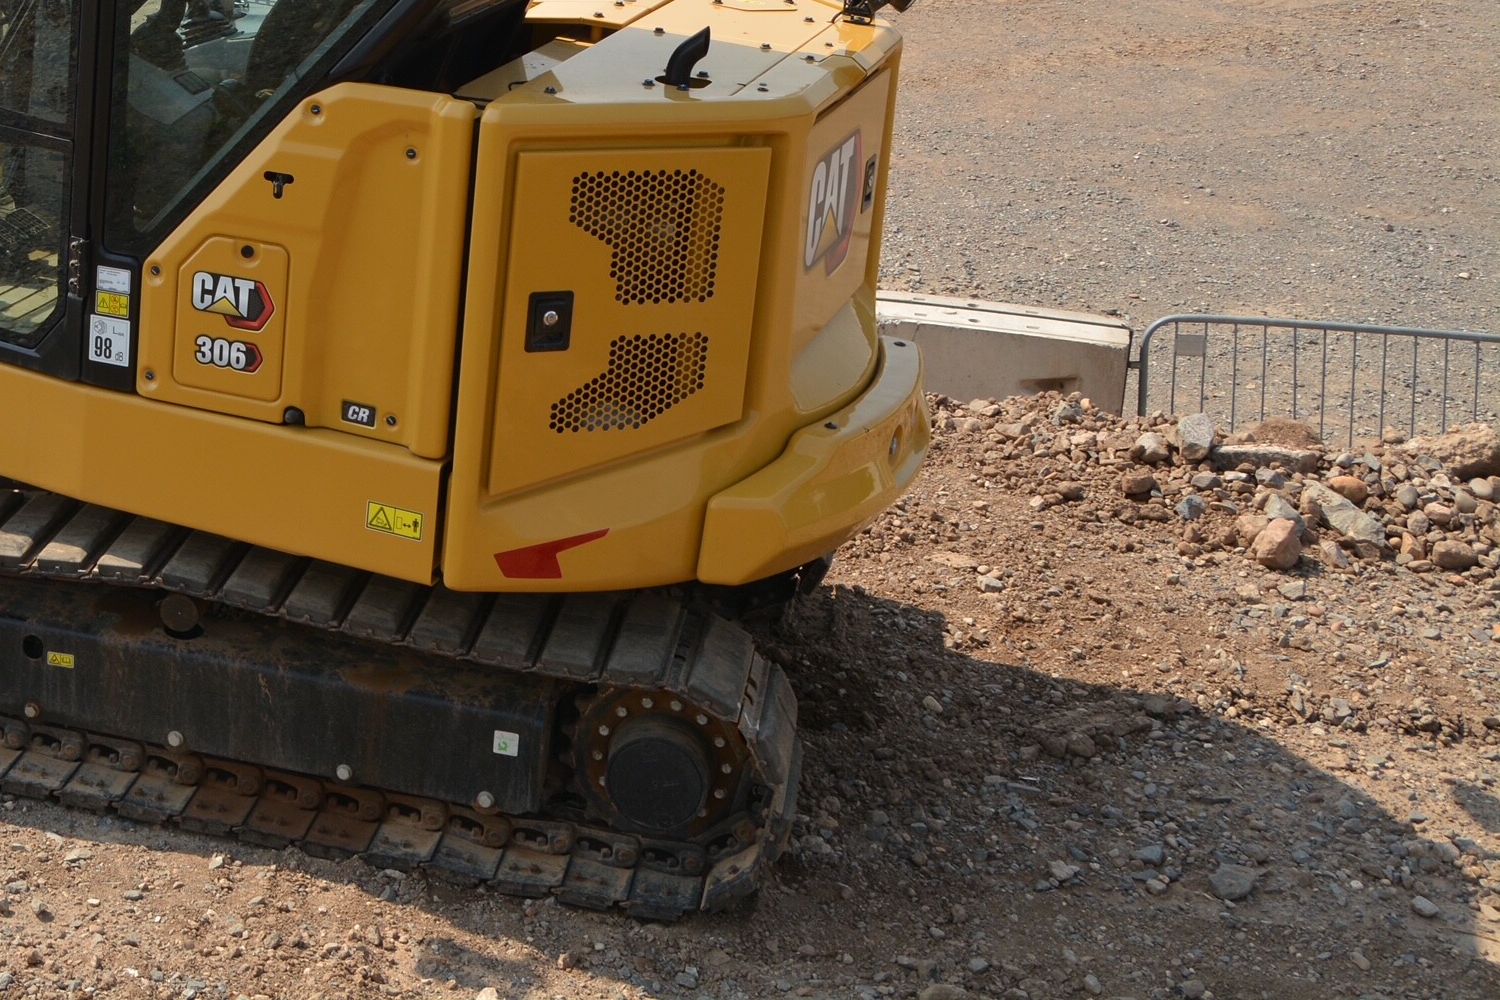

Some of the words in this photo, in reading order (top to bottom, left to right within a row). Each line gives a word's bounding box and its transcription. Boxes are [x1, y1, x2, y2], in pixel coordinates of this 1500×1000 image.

[805, 135, 856, 267] CAT
[192, 271, 255, 318] CAT
[94, 335, 112, 359] 98
[114, 351, 124, 362] dB
[196, 335, 247, 370] 306
[347, 405, 370, 423] CR
